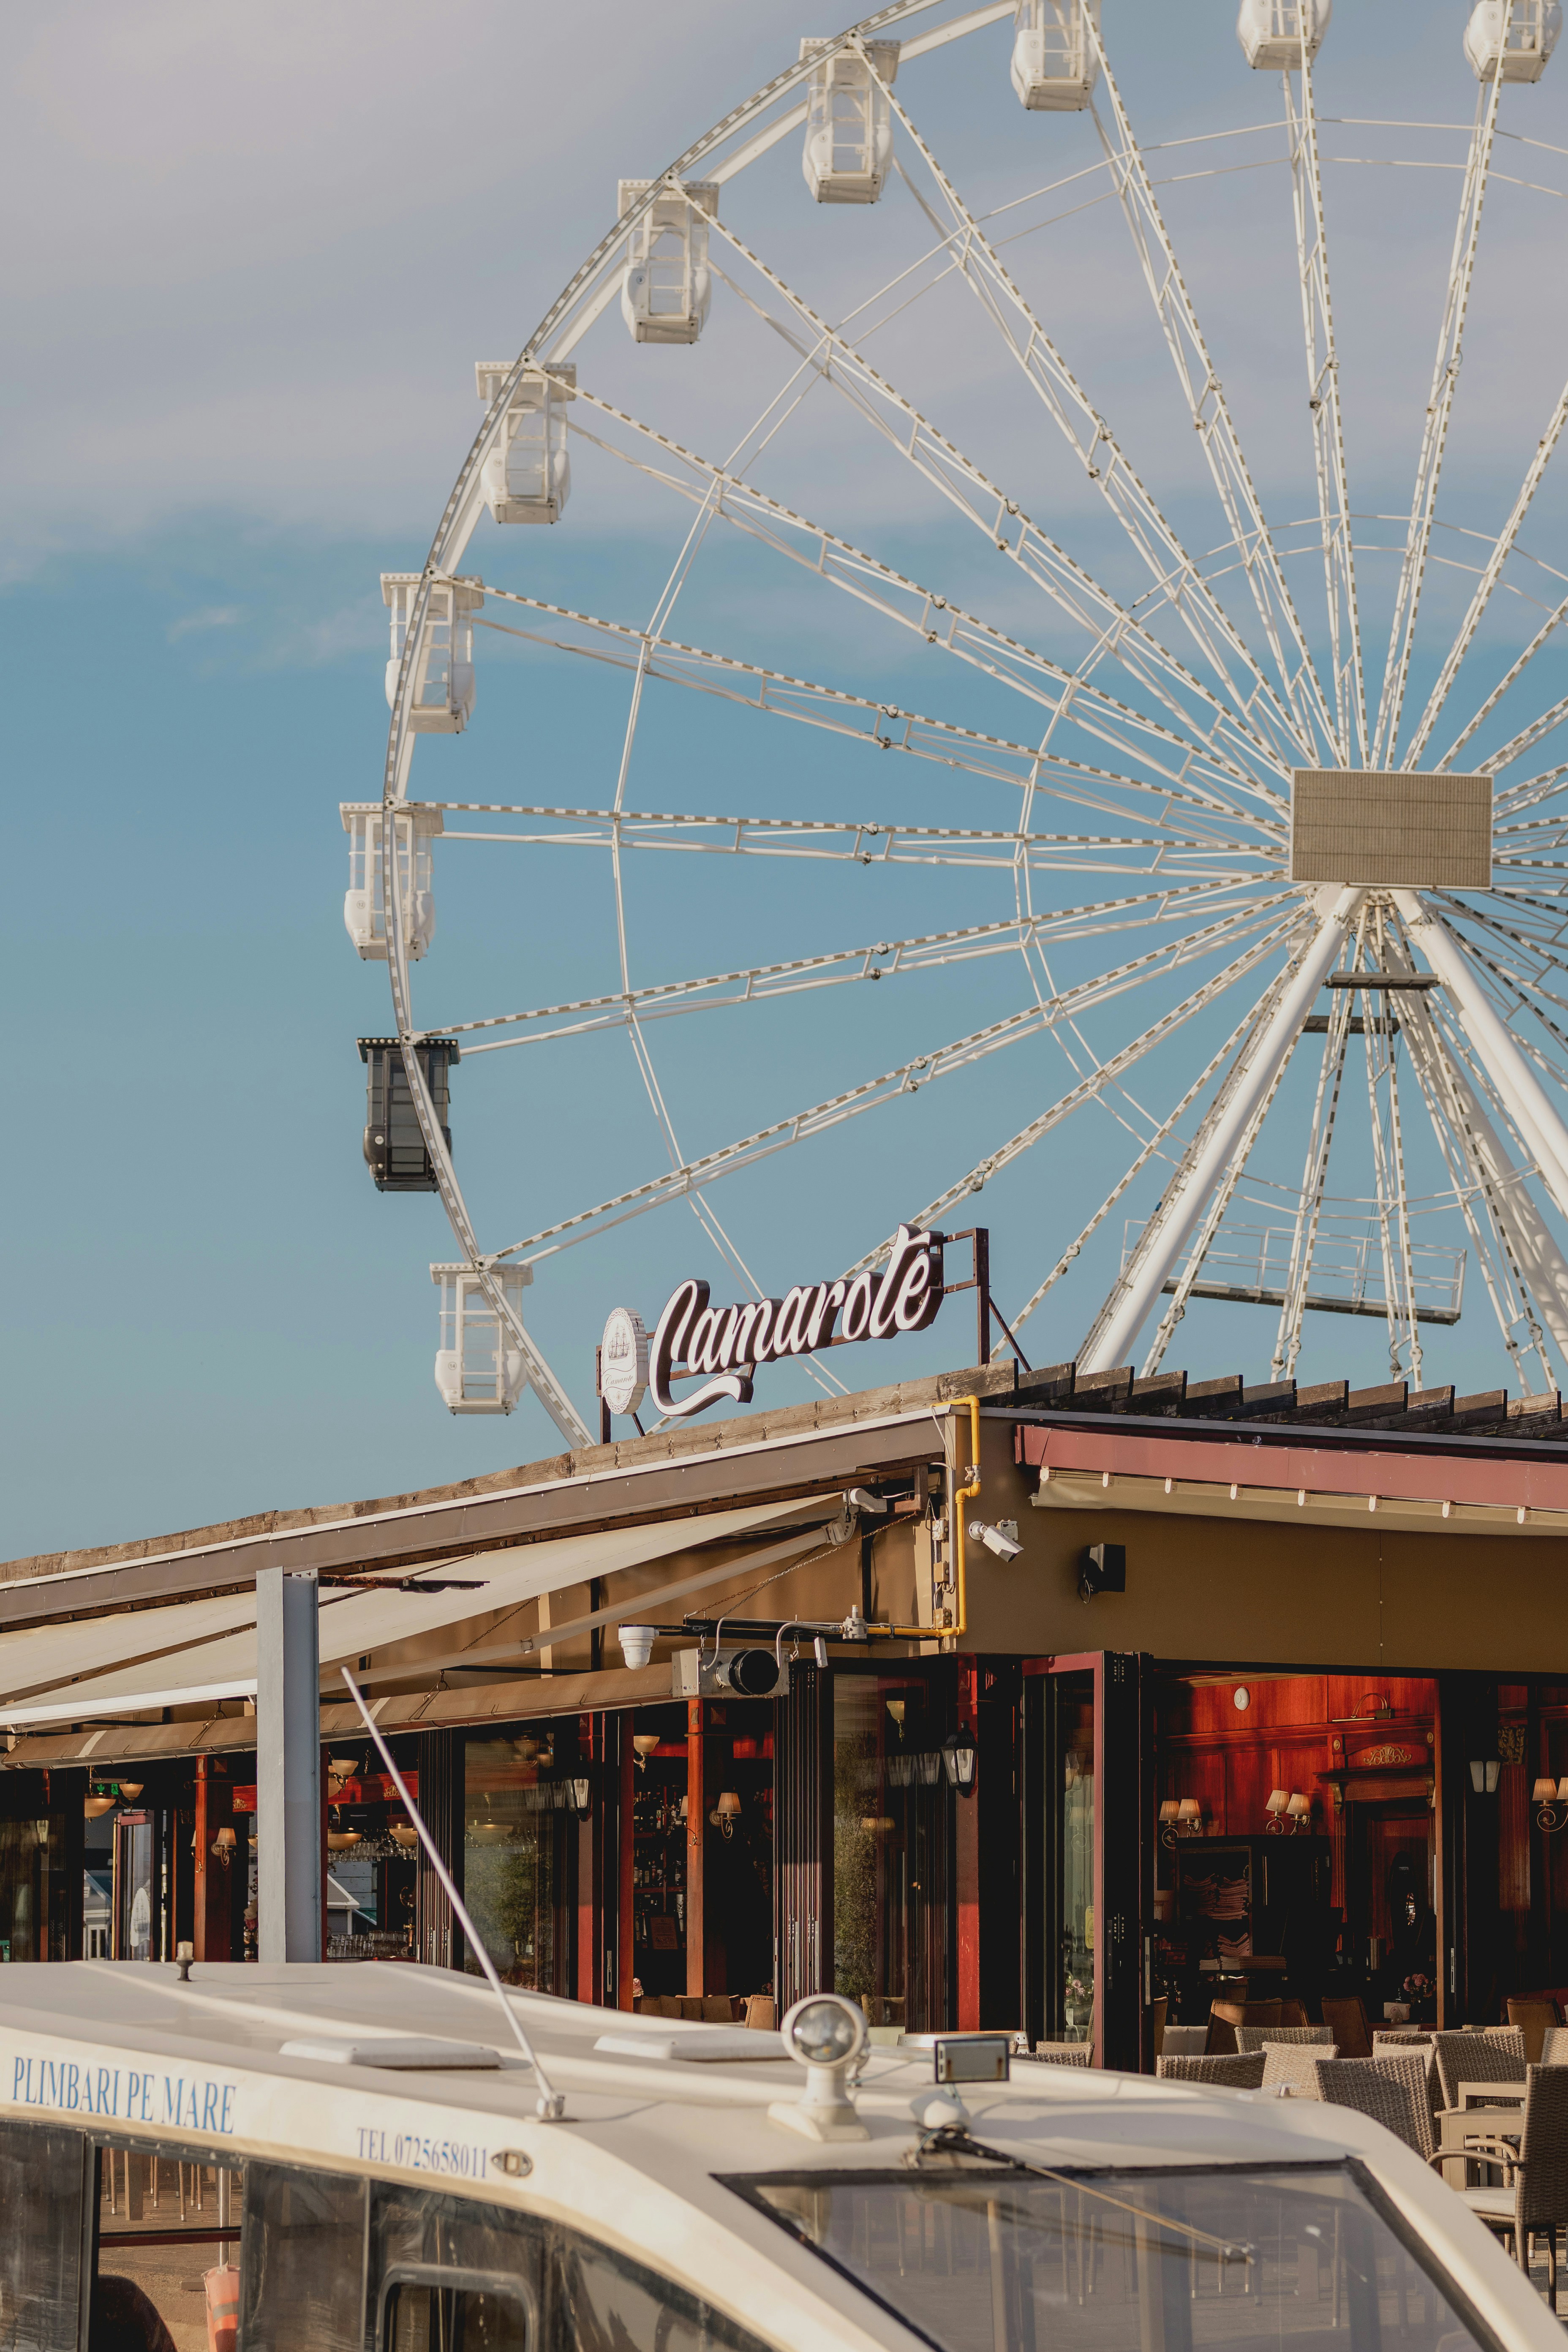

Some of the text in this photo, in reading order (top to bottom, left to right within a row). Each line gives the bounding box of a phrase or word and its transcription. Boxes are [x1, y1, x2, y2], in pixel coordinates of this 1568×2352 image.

[649, 1223, 942, 1416] Camarote
[604, 1374, 633, 1386] Camarote
[12, 2056, 237, 2134] PLIMBARI PE MARE
[357, 2128, 487, 2178] TEL 0725658011
